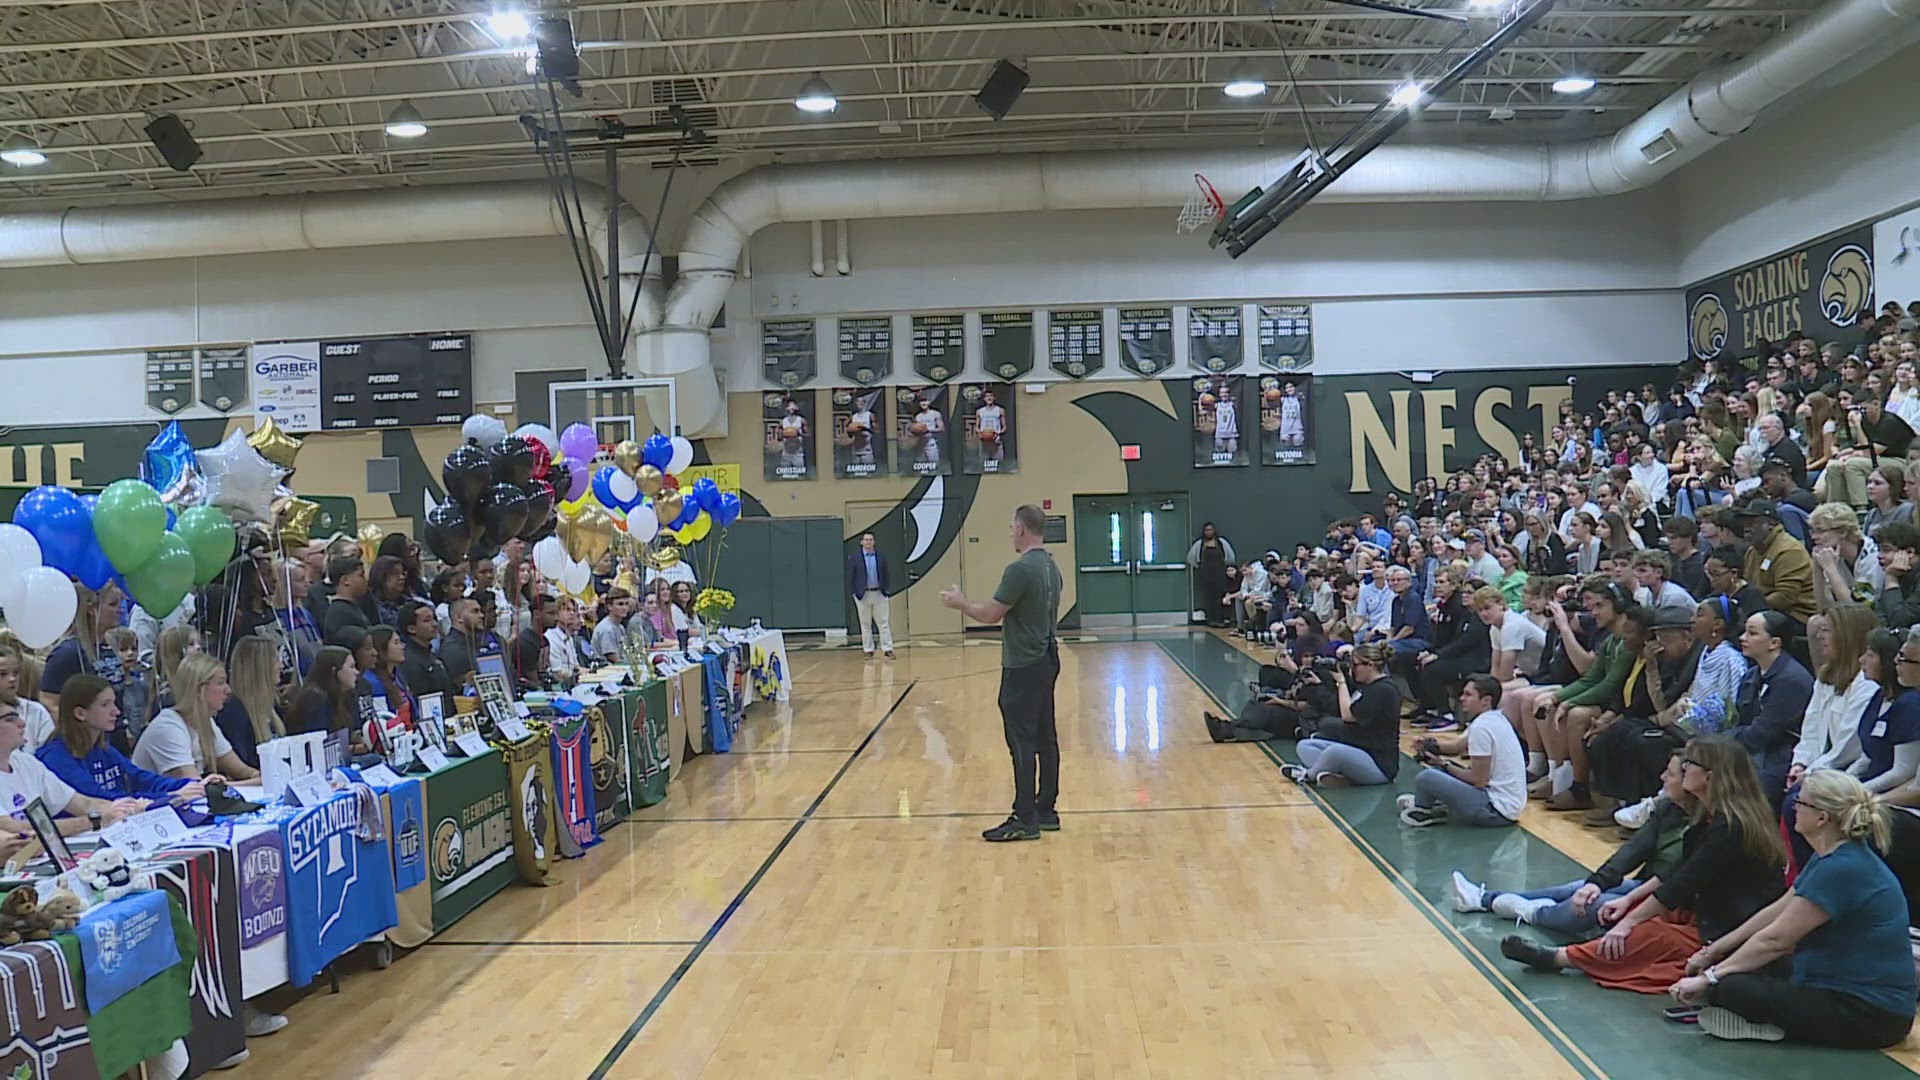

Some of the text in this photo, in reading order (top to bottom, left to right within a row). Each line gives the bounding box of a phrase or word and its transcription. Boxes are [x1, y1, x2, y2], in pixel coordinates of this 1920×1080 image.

[1734, 252, 1810, 312] SOARING
[1743, 297, 1802, 350] EAGLES
[325, 338, 463, 356] GUEST HOME
[256, 362, 317, 375] GARBER
[368, 374, 399, 384] PERIOD
[333, 394, 355, 402] FOULS
[332, 414, 462, 427] POINTS MATCH POINTS
[1343, 385, 1574, 494] NEST
[1275, 450, 1303, 459] VICTORIA
[776, 466, 807, 475] CHRISTIAN
[846, 464, 877, 473] KAMERON
[913, 462, 937, 470] COOPER
[984, 460, 999, 468] LUKE
[291, 795, 360, 861] SYCAMOR
[243, 849, 282, 886] WCU
[244, 905, 285, 940] BOUND
